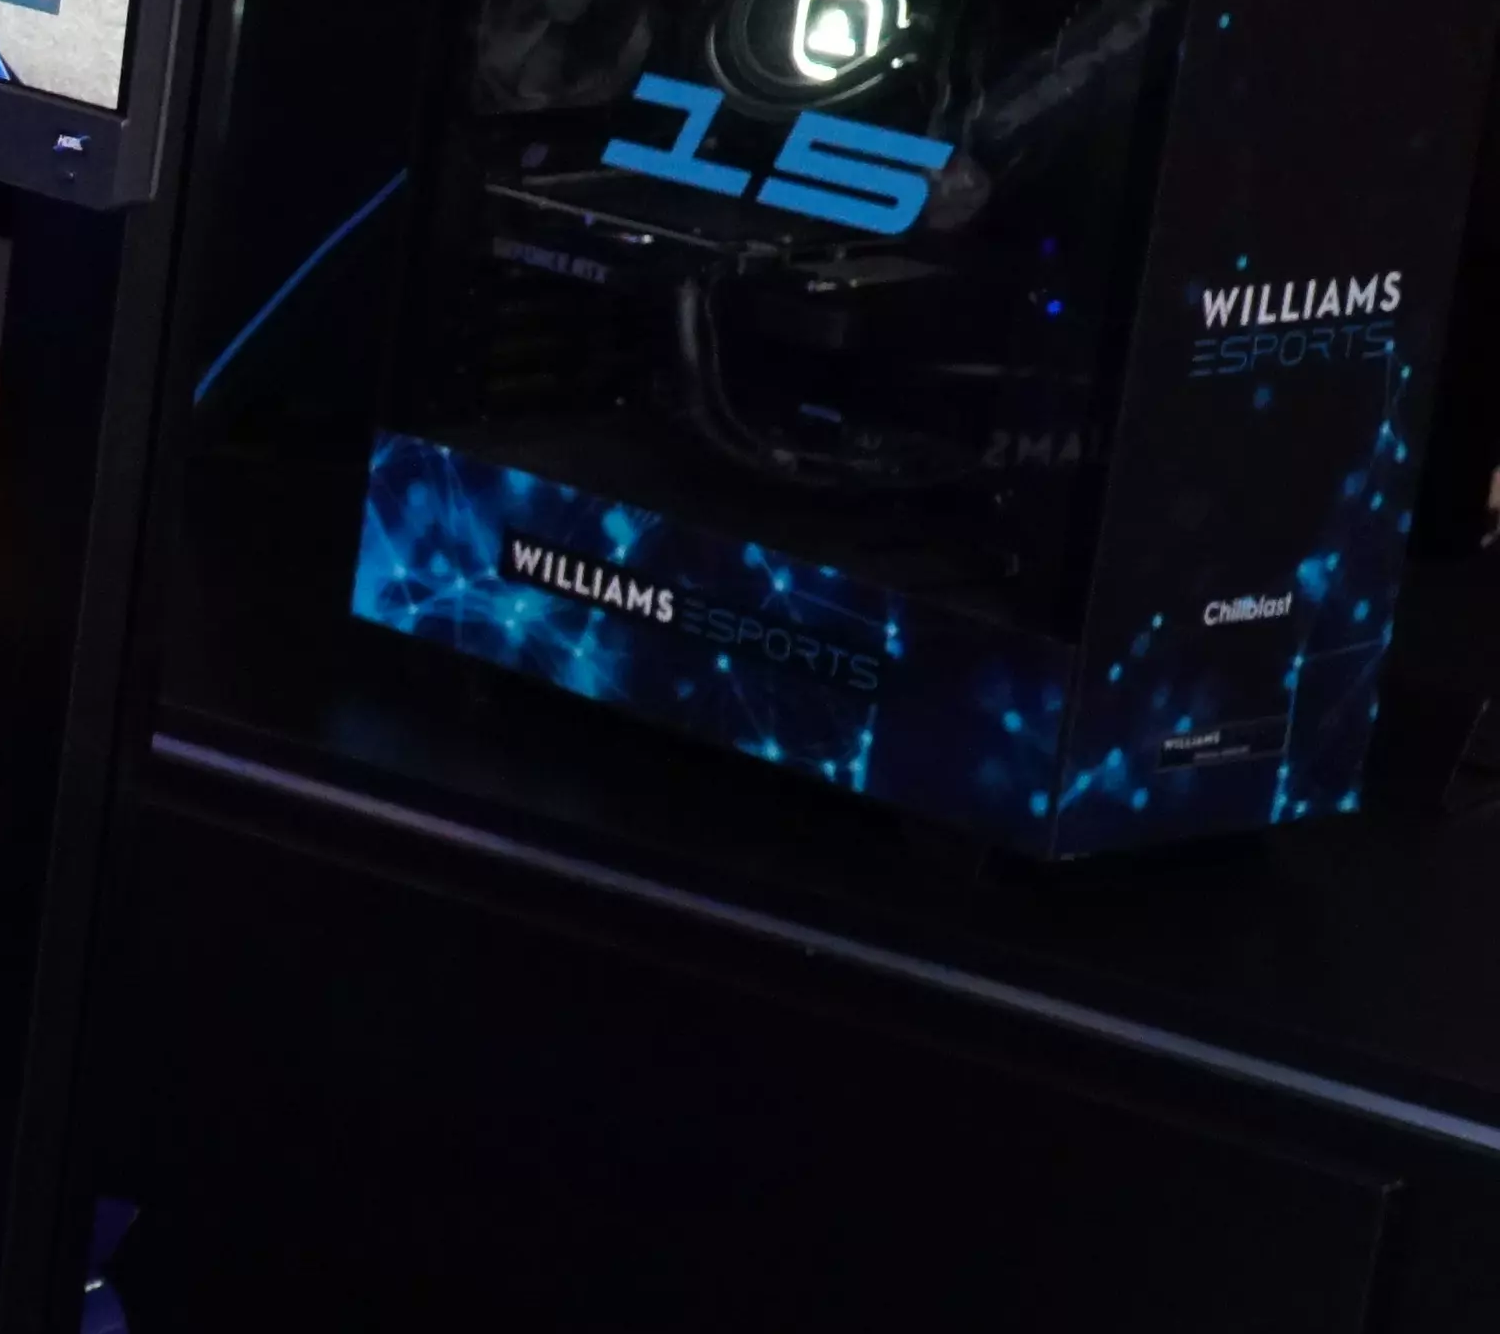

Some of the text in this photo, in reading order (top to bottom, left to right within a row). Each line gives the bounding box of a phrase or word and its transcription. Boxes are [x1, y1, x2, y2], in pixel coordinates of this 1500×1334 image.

[600, 71, 953, 235] 15
[1202, 270, 1402, 330] WILLIAMS
[1188, 319, 1396, 377] ESPORTS
[512, 538, 675, 624] WILLIAMS
[1203, 590, 1294, 627] Chillblast
[680, 597, 880, 692] ESPORTS
